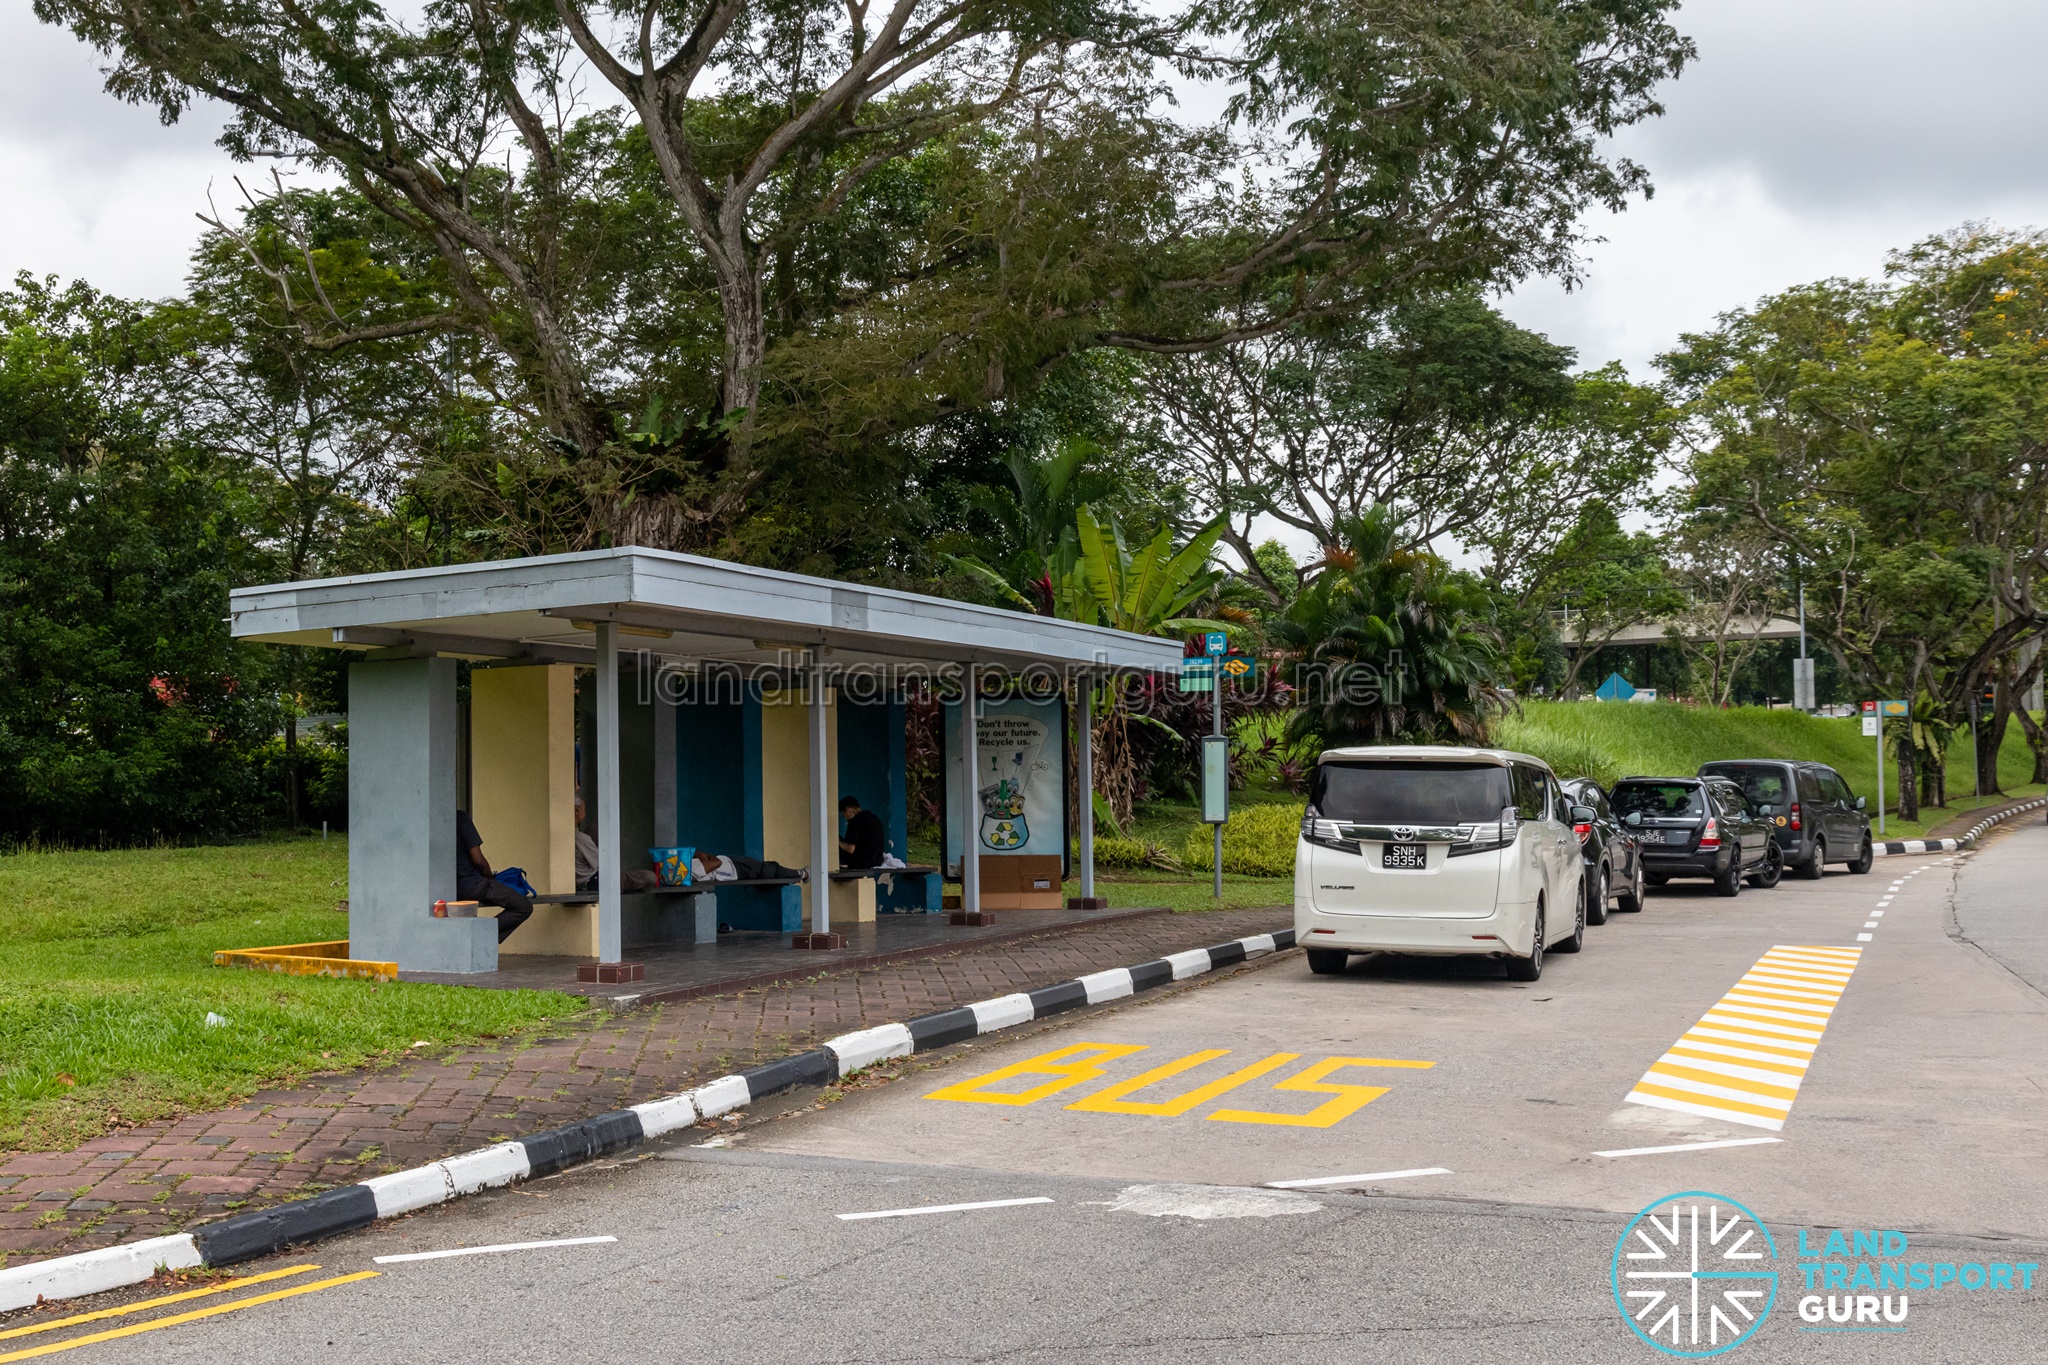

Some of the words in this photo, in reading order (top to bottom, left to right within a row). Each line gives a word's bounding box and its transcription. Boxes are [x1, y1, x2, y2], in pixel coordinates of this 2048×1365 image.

[977, 720, 1001, 728] Don't
[1011, 729, 1041, 737] future.
[979, 738, 1014, 747] Recycle
[1392, 845, 1416, 856] SNH
[1384, 855, 1424, 866] 9935K
[922, 1041, 1437, 1128] BUS
